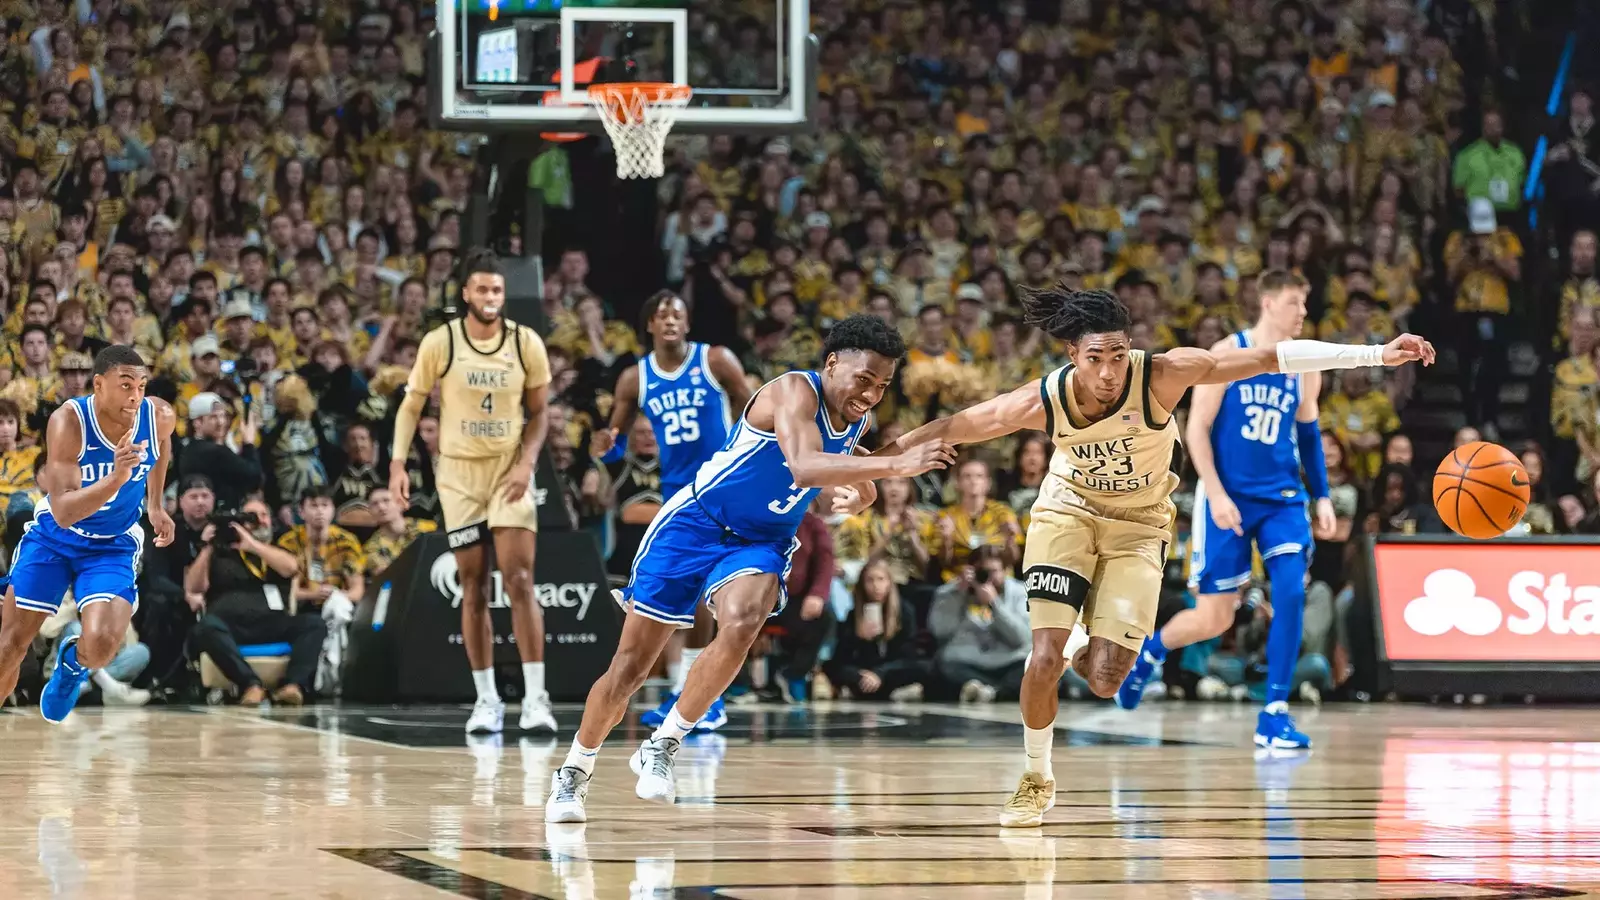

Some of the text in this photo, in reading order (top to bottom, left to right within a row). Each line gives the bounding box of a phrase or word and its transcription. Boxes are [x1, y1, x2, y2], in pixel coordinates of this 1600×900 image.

[466, 371, 509, 388] WAKE
[480, 392, 493, 416] 4
[647, 387, 708, 417] DUKE
[1238, 383, 1296, 414] DUKE
[460, 420, 512, 438] FOREST
[661, 407, 701, 446] 25
[1240, 404, 1283, 446] 30
[1071, 437, 1137, 460] WAKE
[80, 462, 151, 482] DUE
[1088, 455, 1134, 477] 23
[768, 482, 811, 515] 3
[487, 569, 598, 621] lacy
[1507, 569, 1600, 636] Sta
